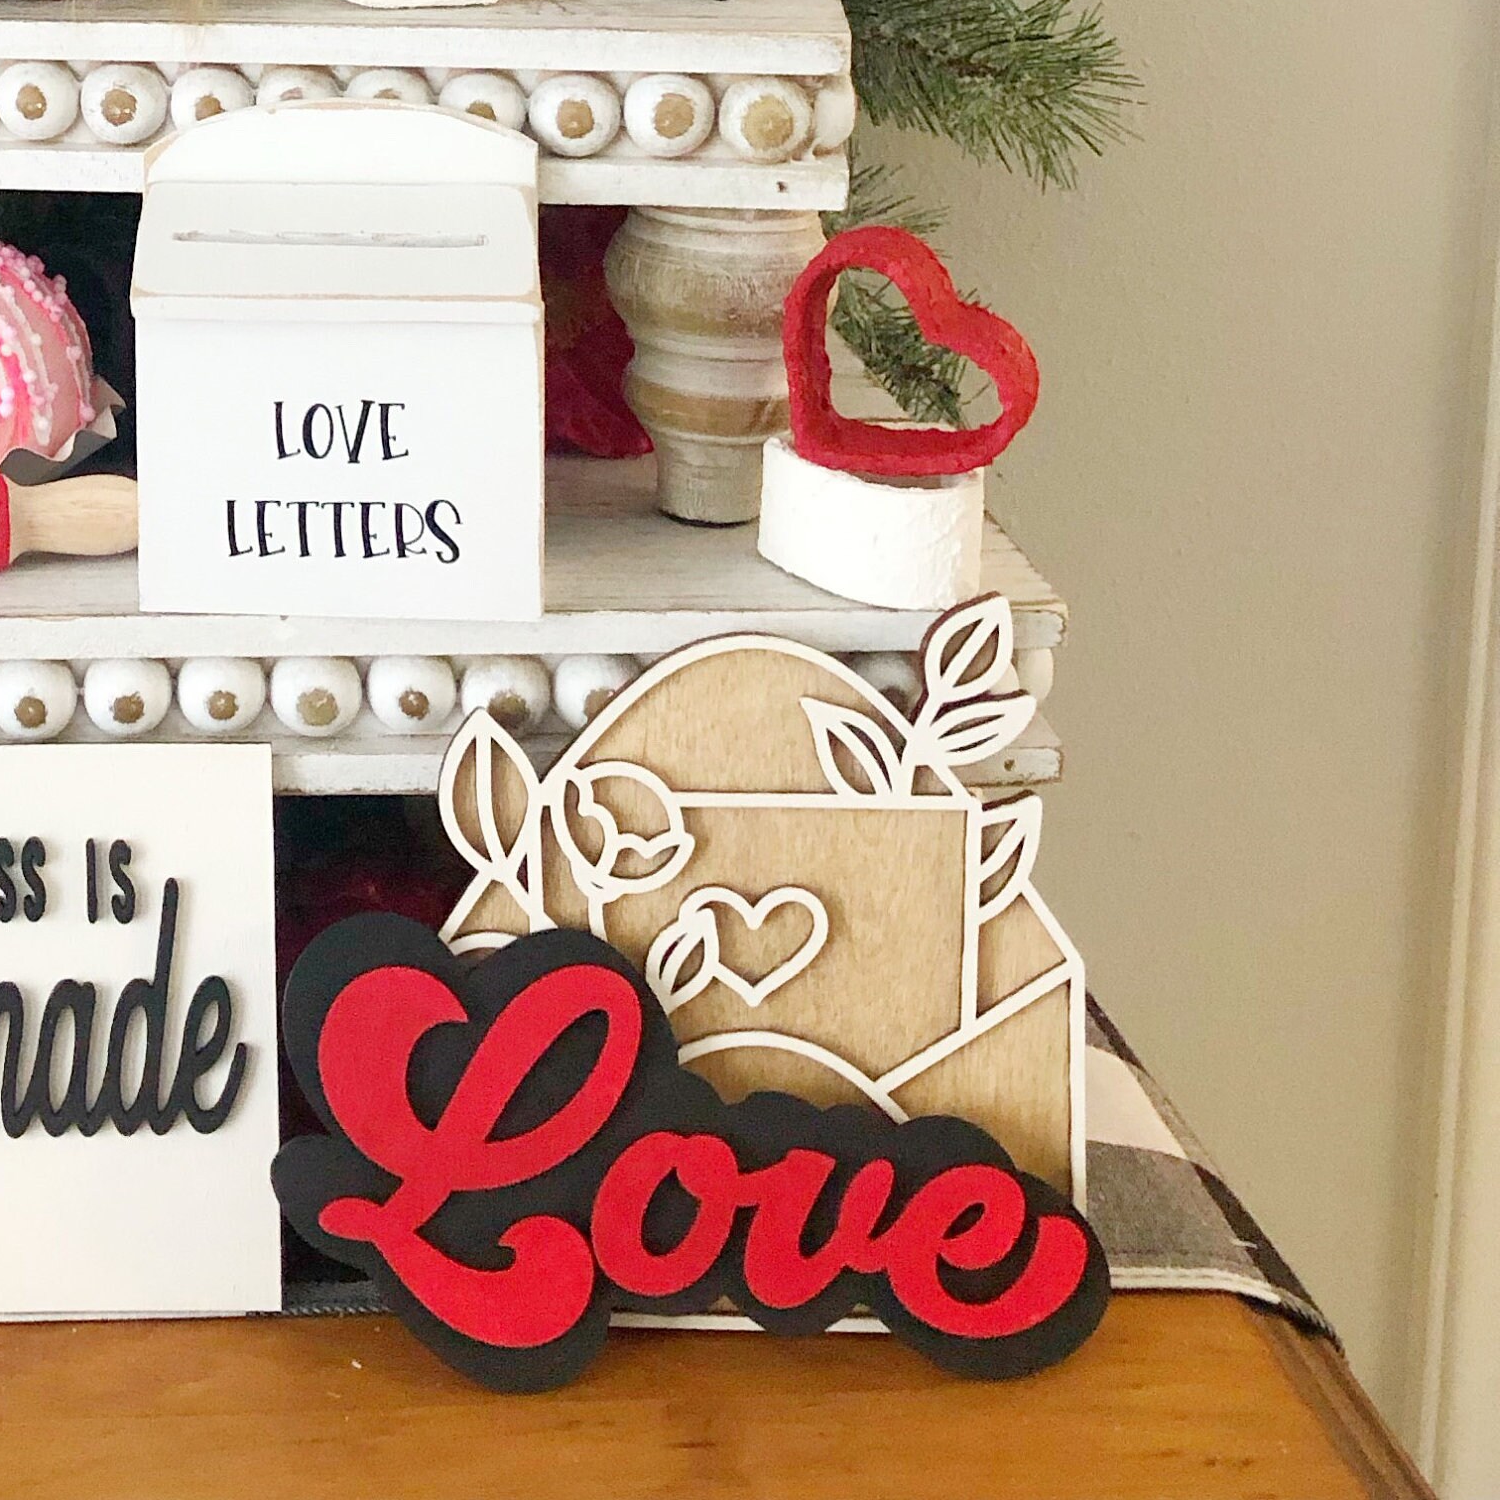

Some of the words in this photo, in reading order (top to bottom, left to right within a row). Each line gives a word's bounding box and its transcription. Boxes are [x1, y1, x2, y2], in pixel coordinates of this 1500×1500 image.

[273, 400, 409, 464] LOVE
[226, 499, 463, 564] LETTERS
[86, 837, 136, 925] IS
[318, 963, 1088, 1349] Love
